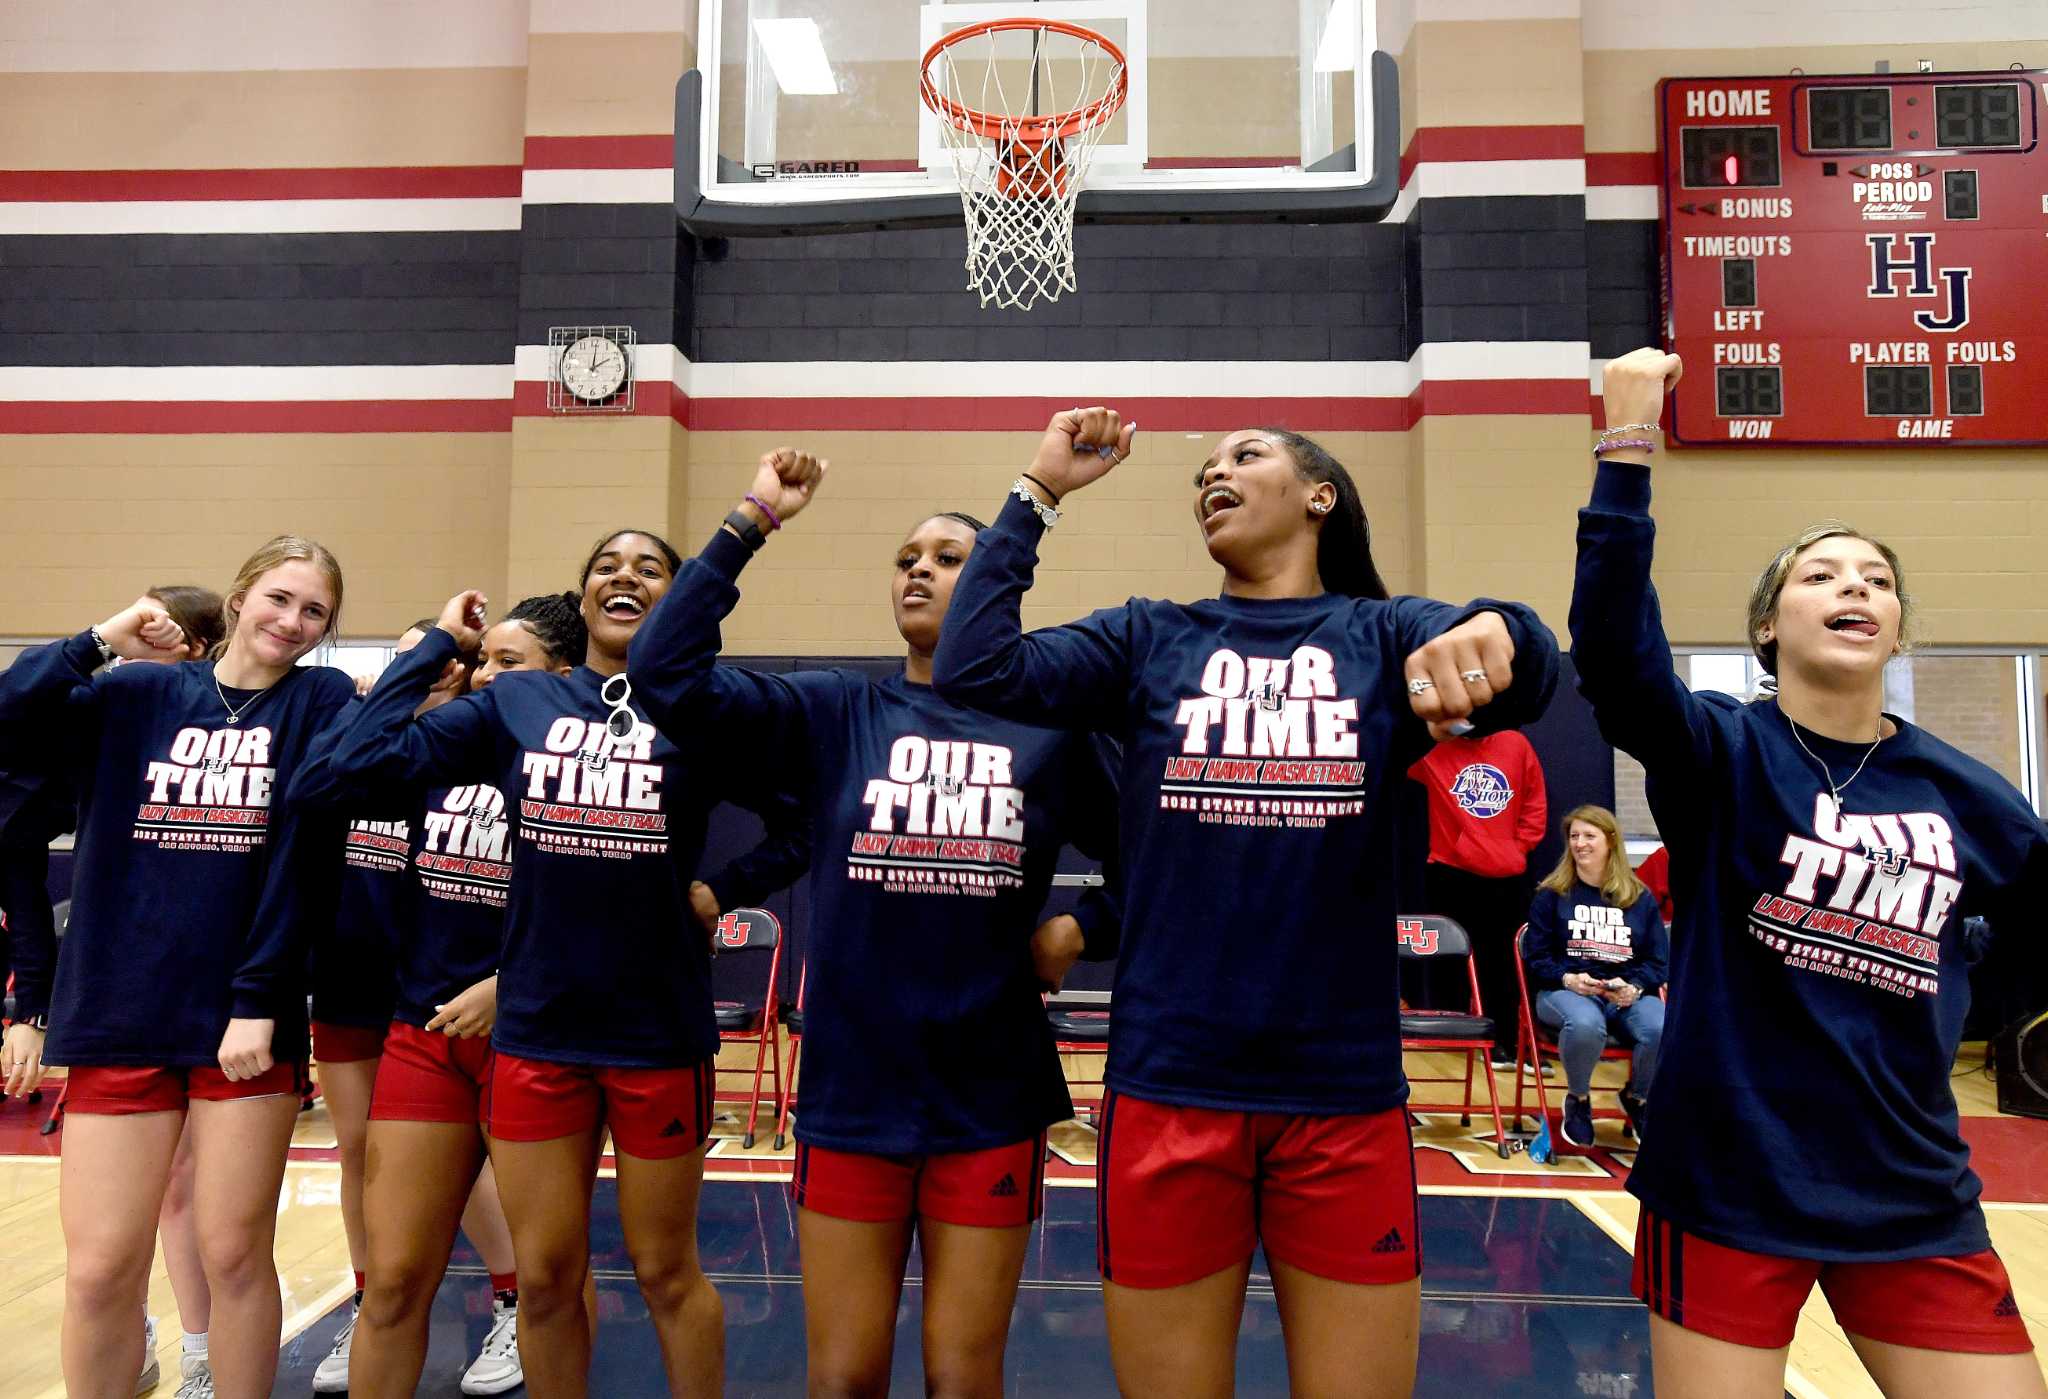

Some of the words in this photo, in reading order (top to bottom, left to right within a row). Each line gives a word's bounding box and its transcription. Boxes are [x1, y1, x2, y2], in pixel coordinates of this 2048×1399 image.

[1687, 89, 1772, 118] HOME
[780, 161, 859, 174] GARED
[1870, 162, 1912, 180] POSS
[1853, 181, 1932, 203] PERIOD
[1721, 198, 1792, 219] BONUS
[1684, 235, 1792, 256] TIMEOUTS
[1865, 232, 1972, 333] HJ
[1713, 311, 1764, 331] LEFT
[1713, 343, 1781, 364] FOULS
[1849, 342, 1930, 364] PLAYER
[1946, 341, 2016, 363] FOULS
[1728, 420, 1772, 439] WON
[1897, 420, 1953, 439] GAME
[1200, 645, 1337, 698] OUR
[545, 717, 657, 761] OUR
[1174, 696, 1359, 758] TIME
[169, 727, 272, 766] OUR
[201, 757, 232, 776] HJ
[576, 750, 611, 773] HJ
[888, 735, 1013, 785] OUR
[1164, 757, 1208, 781] LADY
[1204, 758, 1263, 784] HAWK
[1259, 760, 1366, 786] BASKETBALL
[144, 761, 276, 807] TIME
[522, 751, 664, 810] TIME
[1160, 795, 1197, 810] 2022
[1202, 797, 1254, 813] STATE
[1259, 800, 1364, 816] TOURNAMENT
[1460, 788, 1512, 808] SHOW
[166, 806, 209, 822] HAWK
[542, 804, 587, 824] HAWK
[583, 808, 666, 831] BASKETBALL
[862, 779, 1025, 842] TIME
[162, 832, 201, 842] STATE
[424, 811, 512, 862] TIM
[519, 828, 537, 840] 022
[540, 832, 579, 846] STATE
[582, 837, 668, 853] TOURNAMENT
[1814, 792, 1958, 873] OUR
[890, 834, 941, 858] HAWK
[467, 861, 512, 880] BASKET
[1865, 845, 1910, 879] HJ
[887, 869, 934, 884] STATE
[1779, 833, 1964, 936] TIME
[430, 881, 461, 892] STATE
[464, 885, 507, 899] TOURNA
[1574, 904, 1624, 926] OUR
[1753, 893, 1813, 926] LADY
[1801, 908, 1865, 940] HAWK
[1568, 920, 1632, 947] TIME
[1748, 924, 1787, 952] 2022
[1791, 943, 1843, 965] STATE
[1847, 956, 1938, 995] TOURNAM
